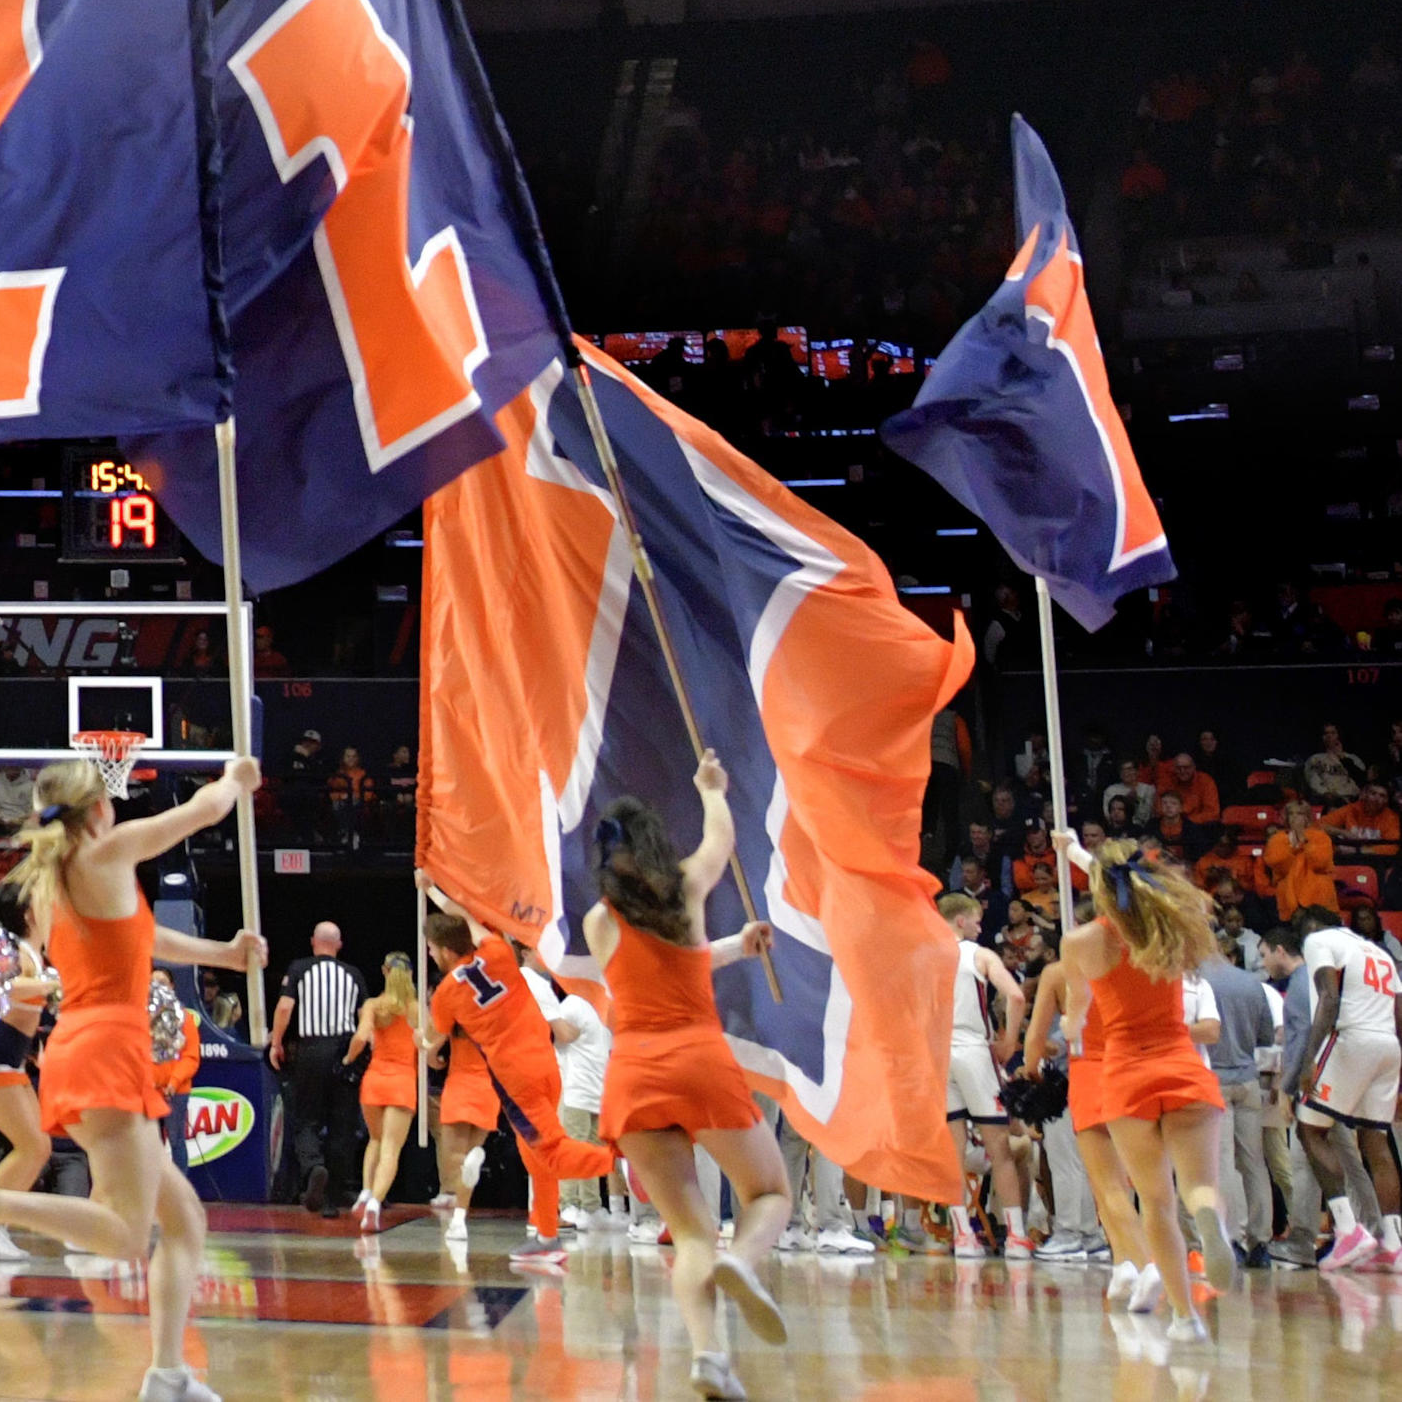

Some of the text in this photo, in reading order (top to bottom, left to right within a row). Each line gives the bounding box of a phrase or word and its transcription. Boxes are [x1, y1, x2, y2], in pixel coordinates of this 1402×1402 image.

[91, 461, 152, 493] 15:4
[110, 494, 155, 548] 19
[1348, 668, 1381, 684] 107
[1363, 956, 1396, 998] 42
[200, 1043, 228, 1058] 1896
[185, 1101, 240, 1140] AN
